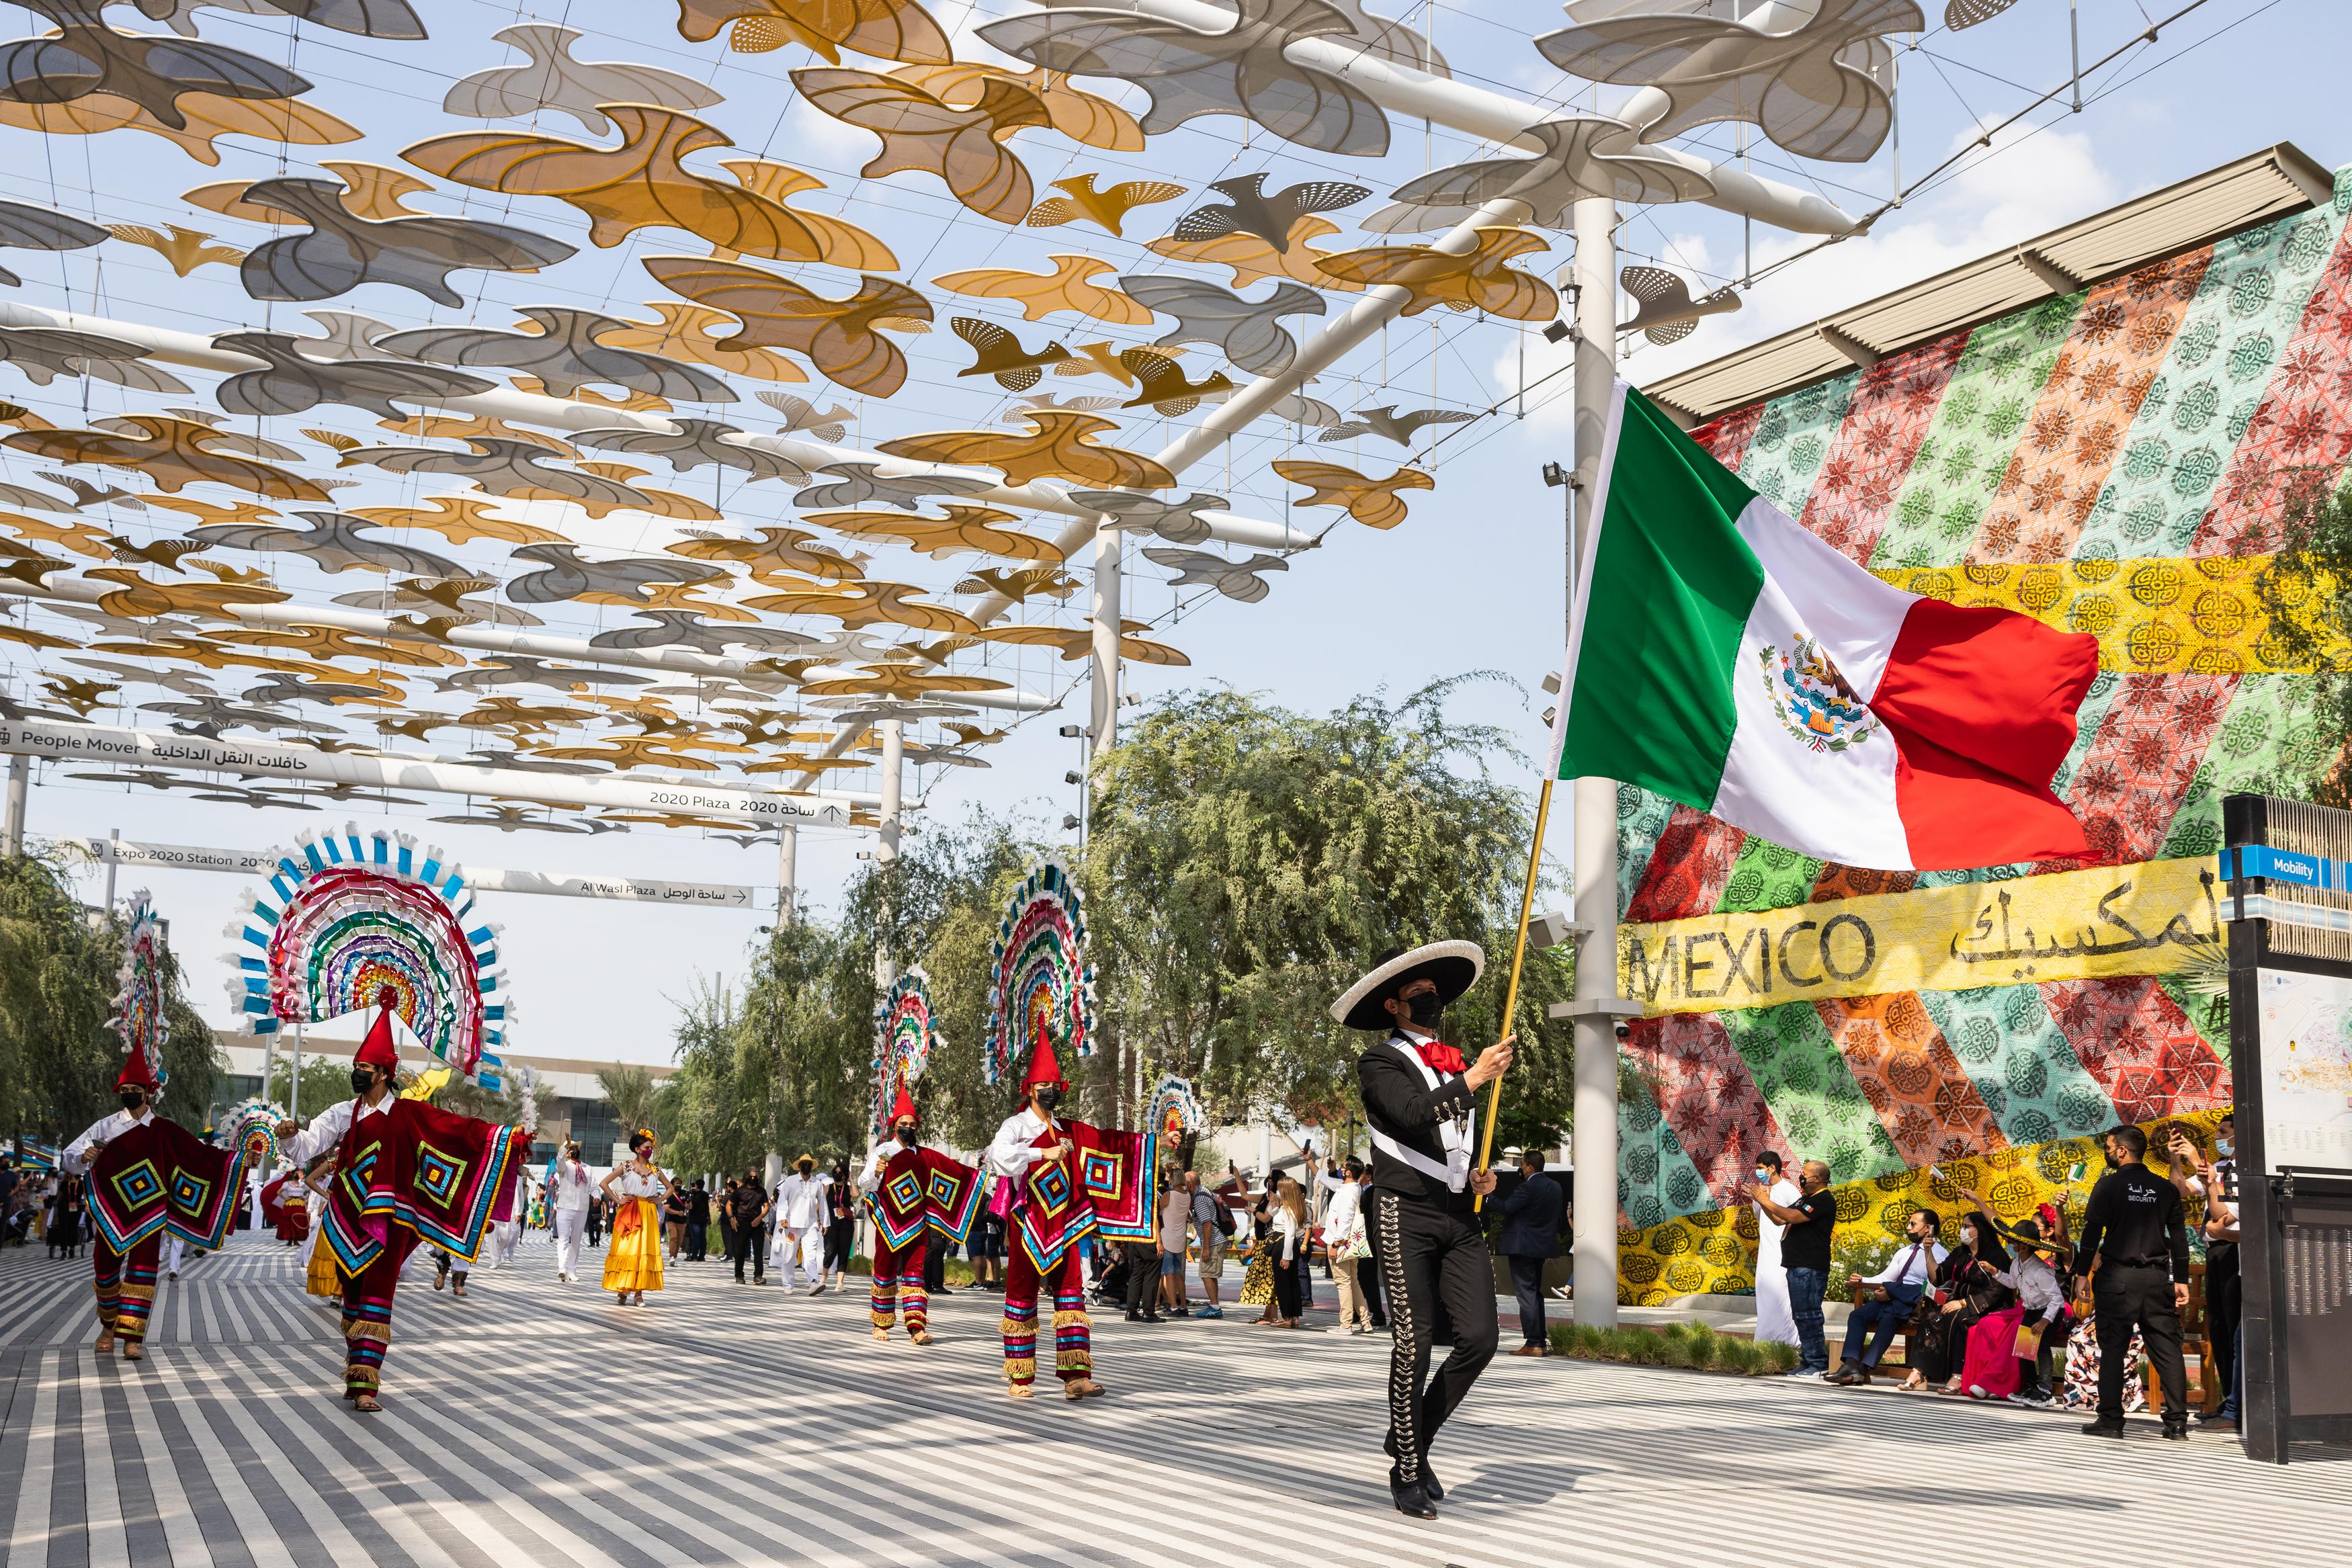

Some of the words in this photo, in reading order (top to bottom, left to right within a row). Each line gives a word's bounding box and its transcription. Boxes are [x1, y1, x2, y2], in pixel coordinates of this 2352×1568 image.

[22, 731, 81, 750] People
[87, 738, 141, 754] Mover
[152, 744, 210, 760] الداخلية
[214, 750, 253, 766] النقل
[257, 756, 307, 769] حافلات
[650, 792, 689, 805] 2020
[694, 796, 730, 810] Plaza
[740, 800, 778, 814] 2020
[781, 803, 814, 817] ساحة
[113, 847, 145, 860] Expo
[149, 851, 183, 861] 2020
[187, 853, 232, 865] Station
[2273, 857, 2314, 880] Mobility
[581, 882, 592, 891] Al
[596, 883, 622, 894] Wasl
[626, 885, 656, 896] Plaza
[663, 887, 695, 900] الوصل
[698, 890, 725, 900] ساحة
[1950, 867, 2220, 980] لمكسيك
[1626, 913, 1876, 1002] MEXICO
[2128, 1183, 2156, 1196] حراسة
